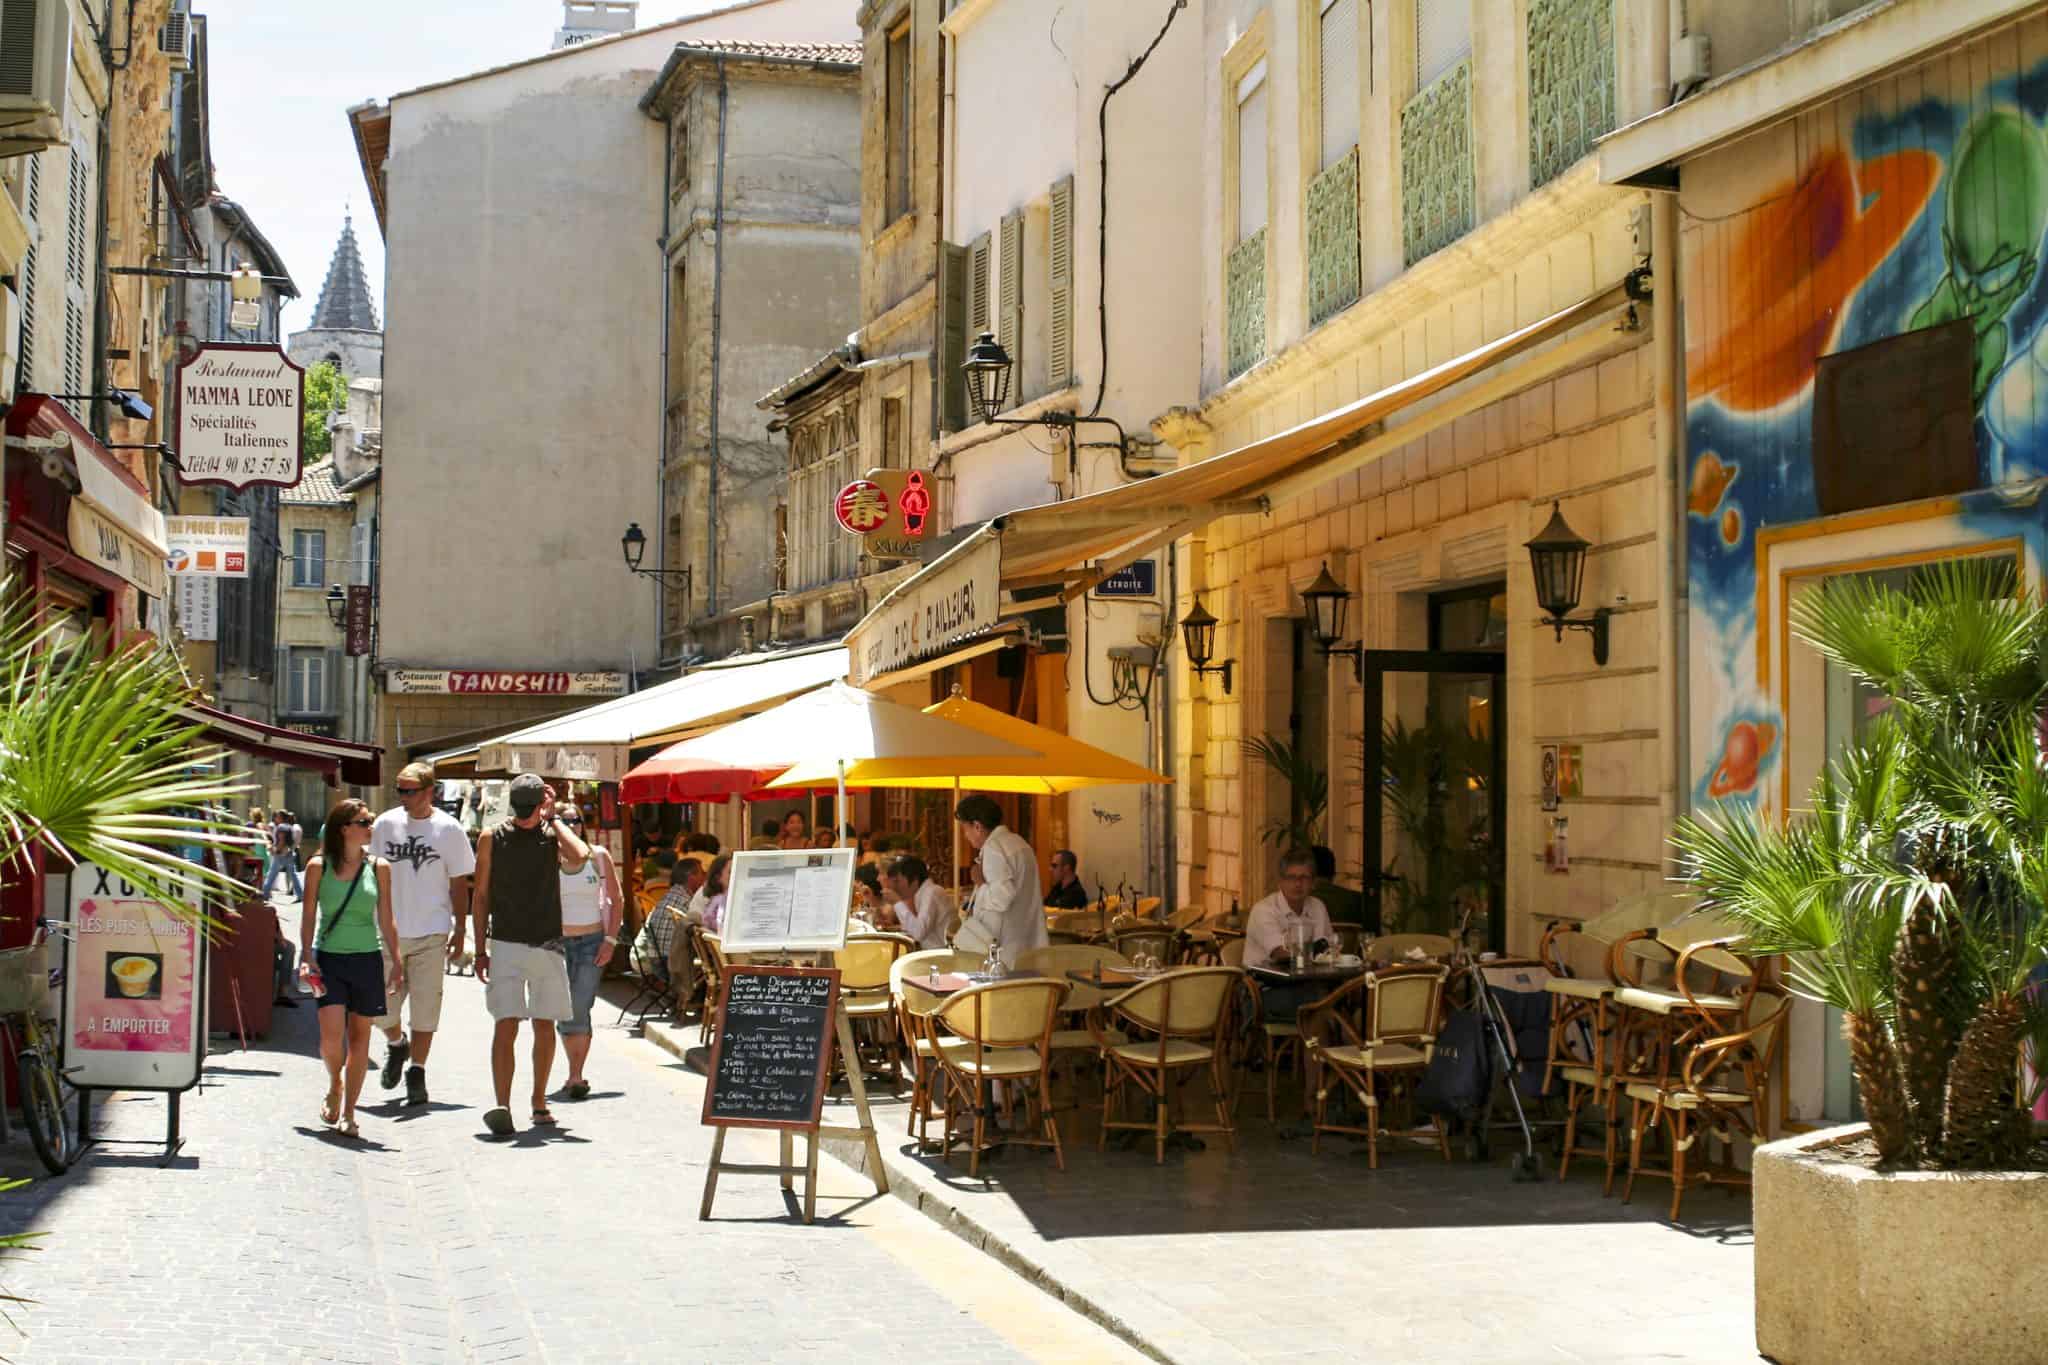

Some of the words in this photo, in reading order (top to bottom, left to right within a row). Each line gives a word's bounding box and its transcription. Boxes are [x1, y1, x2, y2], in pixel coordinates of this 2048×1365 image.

[195, 359, 284, 379] Restaurant
[186, 385, 240, 406] MAMMA
[248, 387, 293, 407] LEONE
[190, 414, 257, 432] Spécialités
[224, 432, 289, 448] Italiennes
[225, 456, 239, 473] 90
[260, 457, 275, 474] 57
[277, 457, 293, 474] 58
[226, 557, 243, 567] SFR
[394, 671, 443, 681] Restaurant
[80, 918, 102, 934] LES
[103, 1017, 169, 1034] EMPORTER
